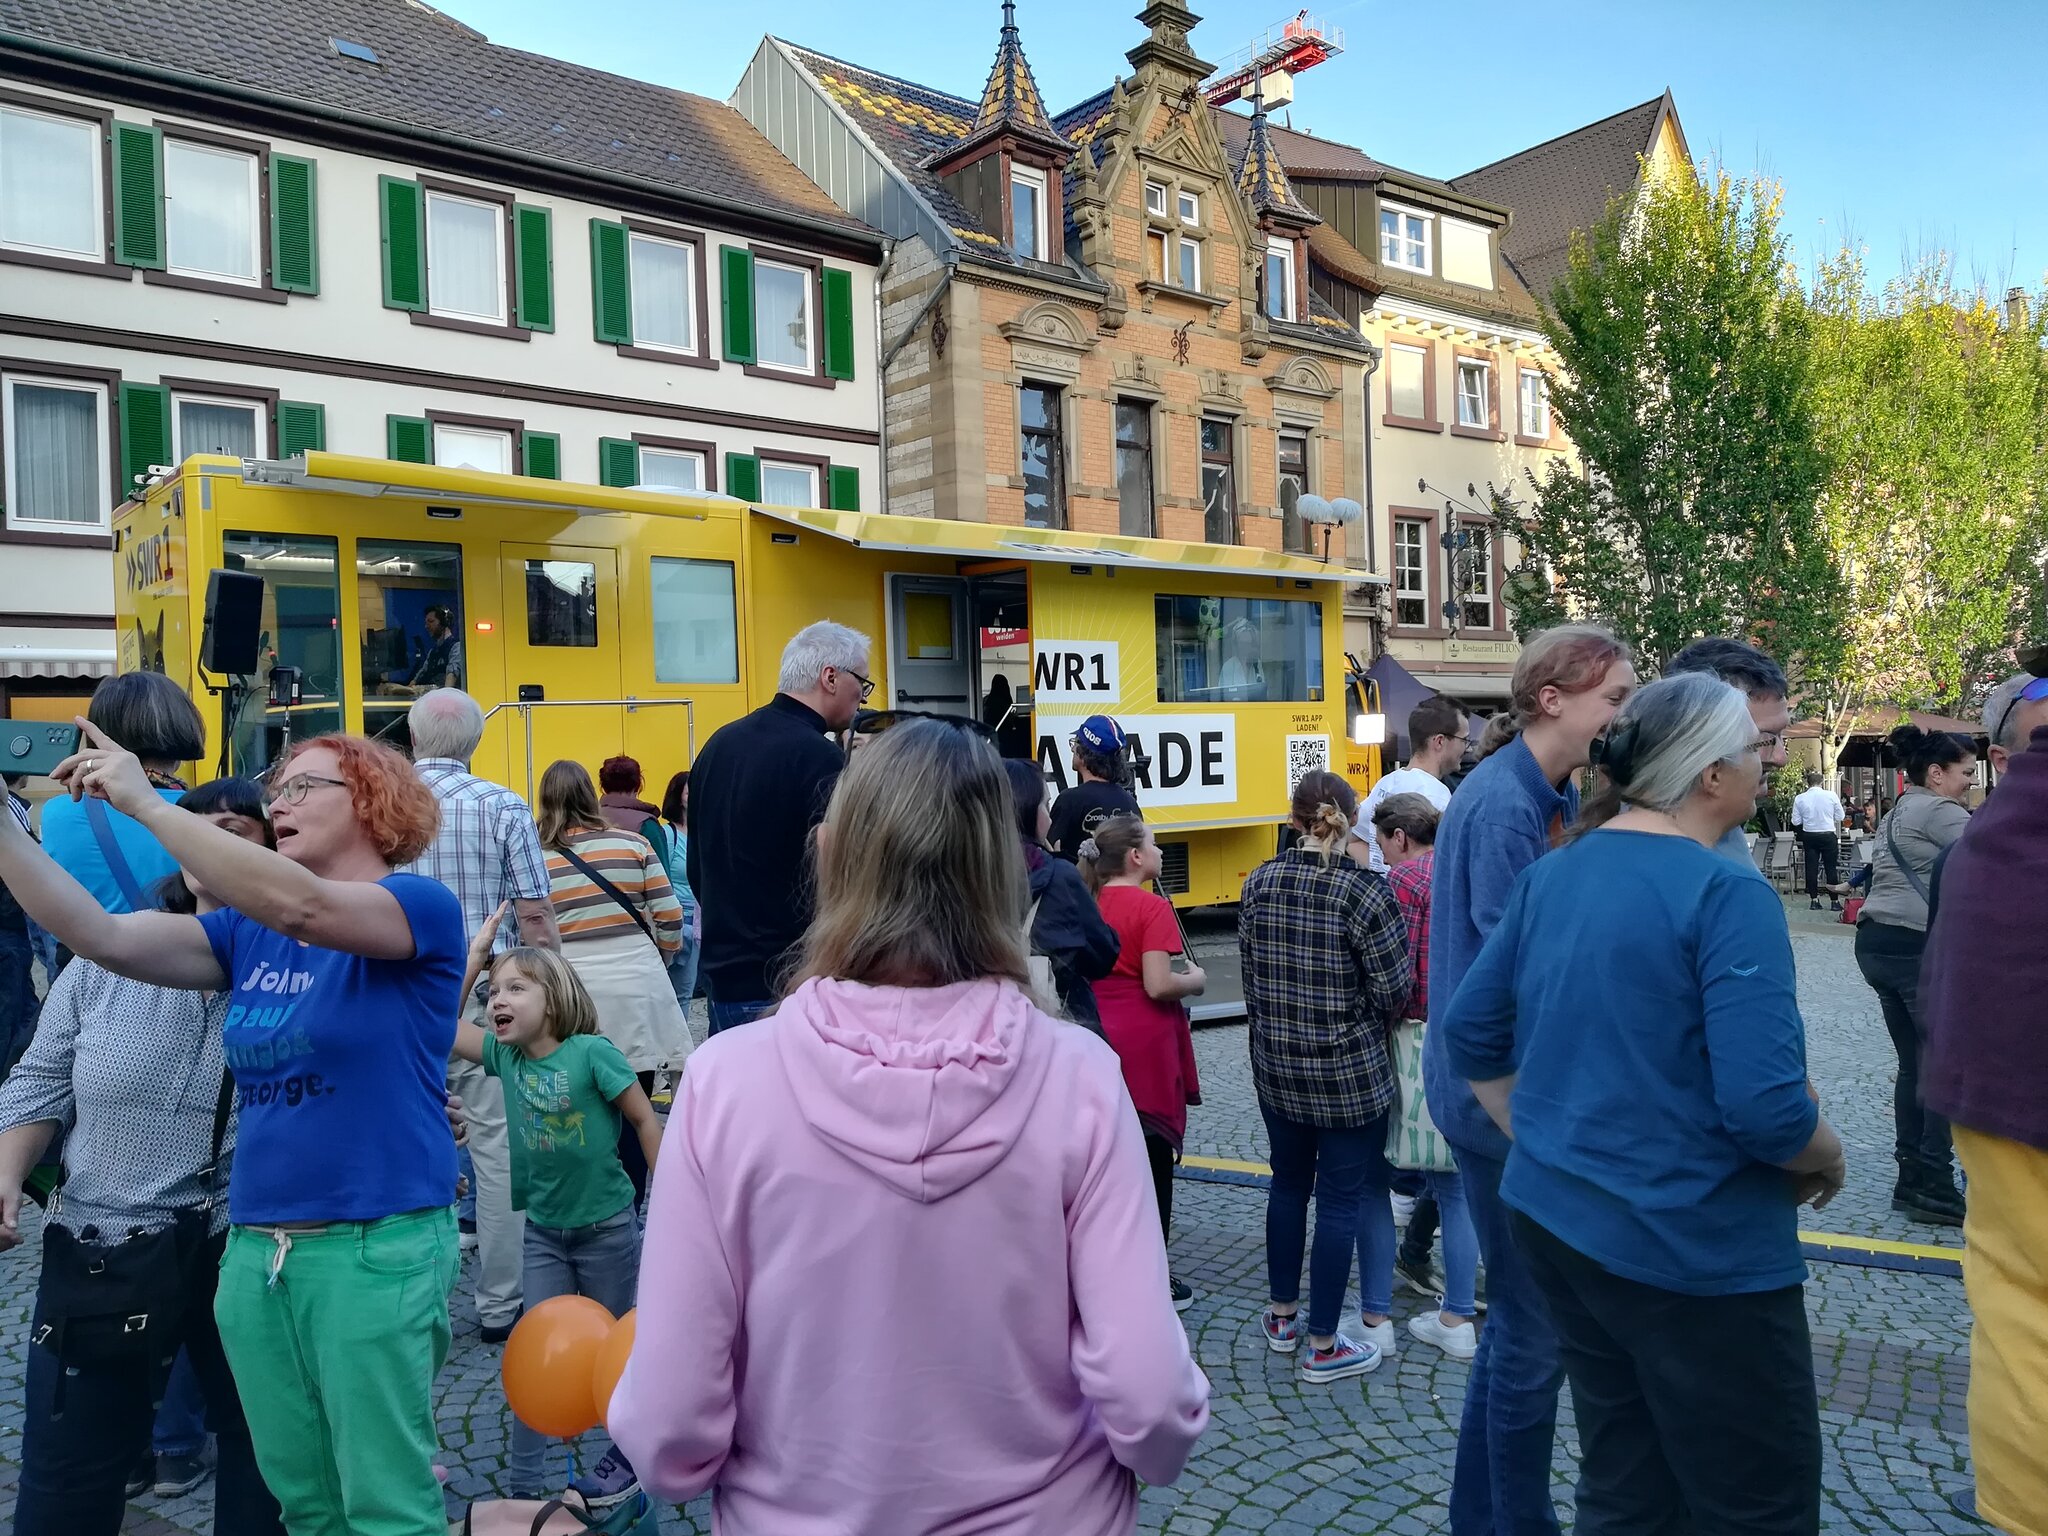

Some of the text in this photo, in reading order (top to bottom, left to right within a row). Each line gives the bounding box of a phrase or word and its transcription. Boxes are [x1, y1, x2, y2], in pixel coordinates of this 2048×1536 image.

[136, 524, 174, 591] SWR1
[1462, 643, 1493, 653] Restaurant
[1291, 714, 1323, 723] SWR1 APP
[1296, 723, 1319, 732] LADEN!
